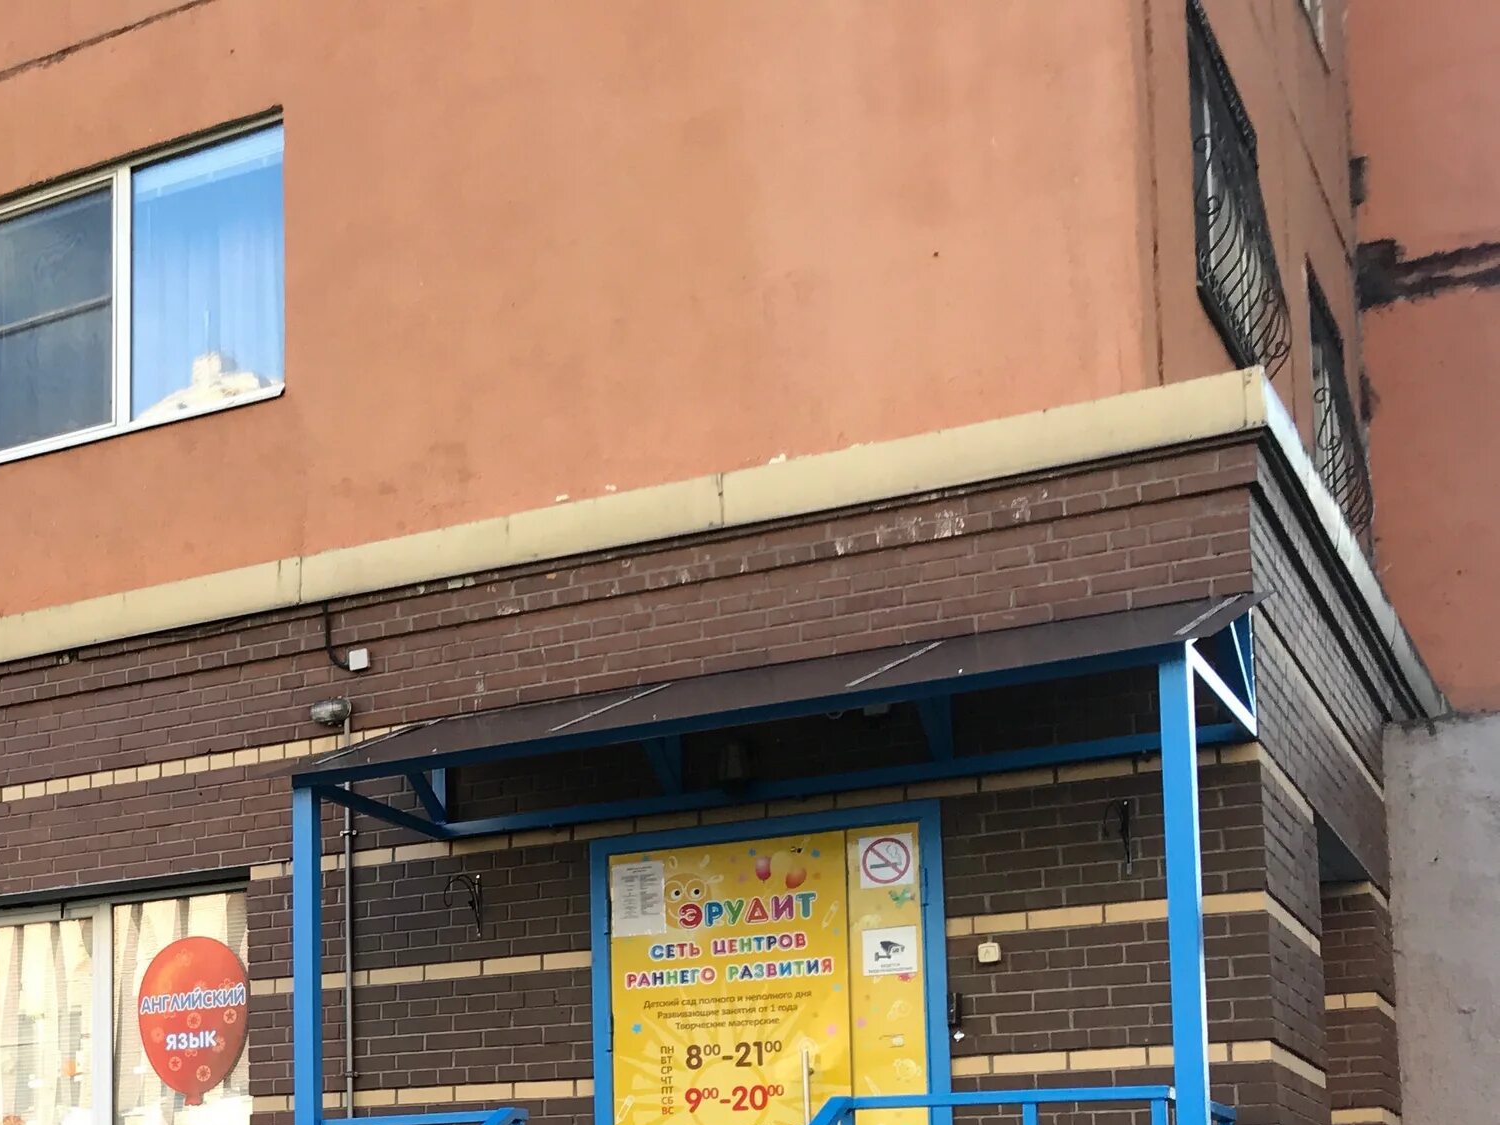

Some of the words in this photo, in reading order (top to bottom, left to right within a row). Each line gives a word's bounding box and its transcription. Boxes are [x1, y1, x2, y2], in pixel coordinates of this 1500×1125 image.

[679, 892, 816, 928] ЭРУДИТ
[650, 943, 702, 961] СЕТЬ
[712, 933, 807, 955] ЦЕНТРОВ
[625, 967, 716, 990] РАННЕГО
[726, 957, 834, 981] РАЗВИТИЯ
[140, 983, 246, 1014] АНГЛИЙСКИЙ
[644, 998, 679, 1009] Детский
[681, 999, 697, 1007] сад
[699, 996, 734, 1005] полного
[745, 992, 792, 1002] неполного
[794, 990, 812, 1000] дня
[657, 1009, 720, 1019] Развивающие
[721, 1006, 756, 1015] занятия
[758, 1005, 768, 1013] от
[770, 1004, 776, 1012] 1
[778, 1004, 798, 1012] года
[675, 1021, 726, 1031] Творческие
[728, 1017, 780, 1028] мастерские
[166, 1031, 217, 1051] ЯЗЫК
[660, 1046, 674, 1054] ПН
[661, 1066, 673, 1075] СР
[661, 1076, 673, 1085] ЧТ
[661, 1086, 673, 1095] ПТ
[661, 1096, 674, 1104] СБ
[661, 1106, 674, 1115] ВС
